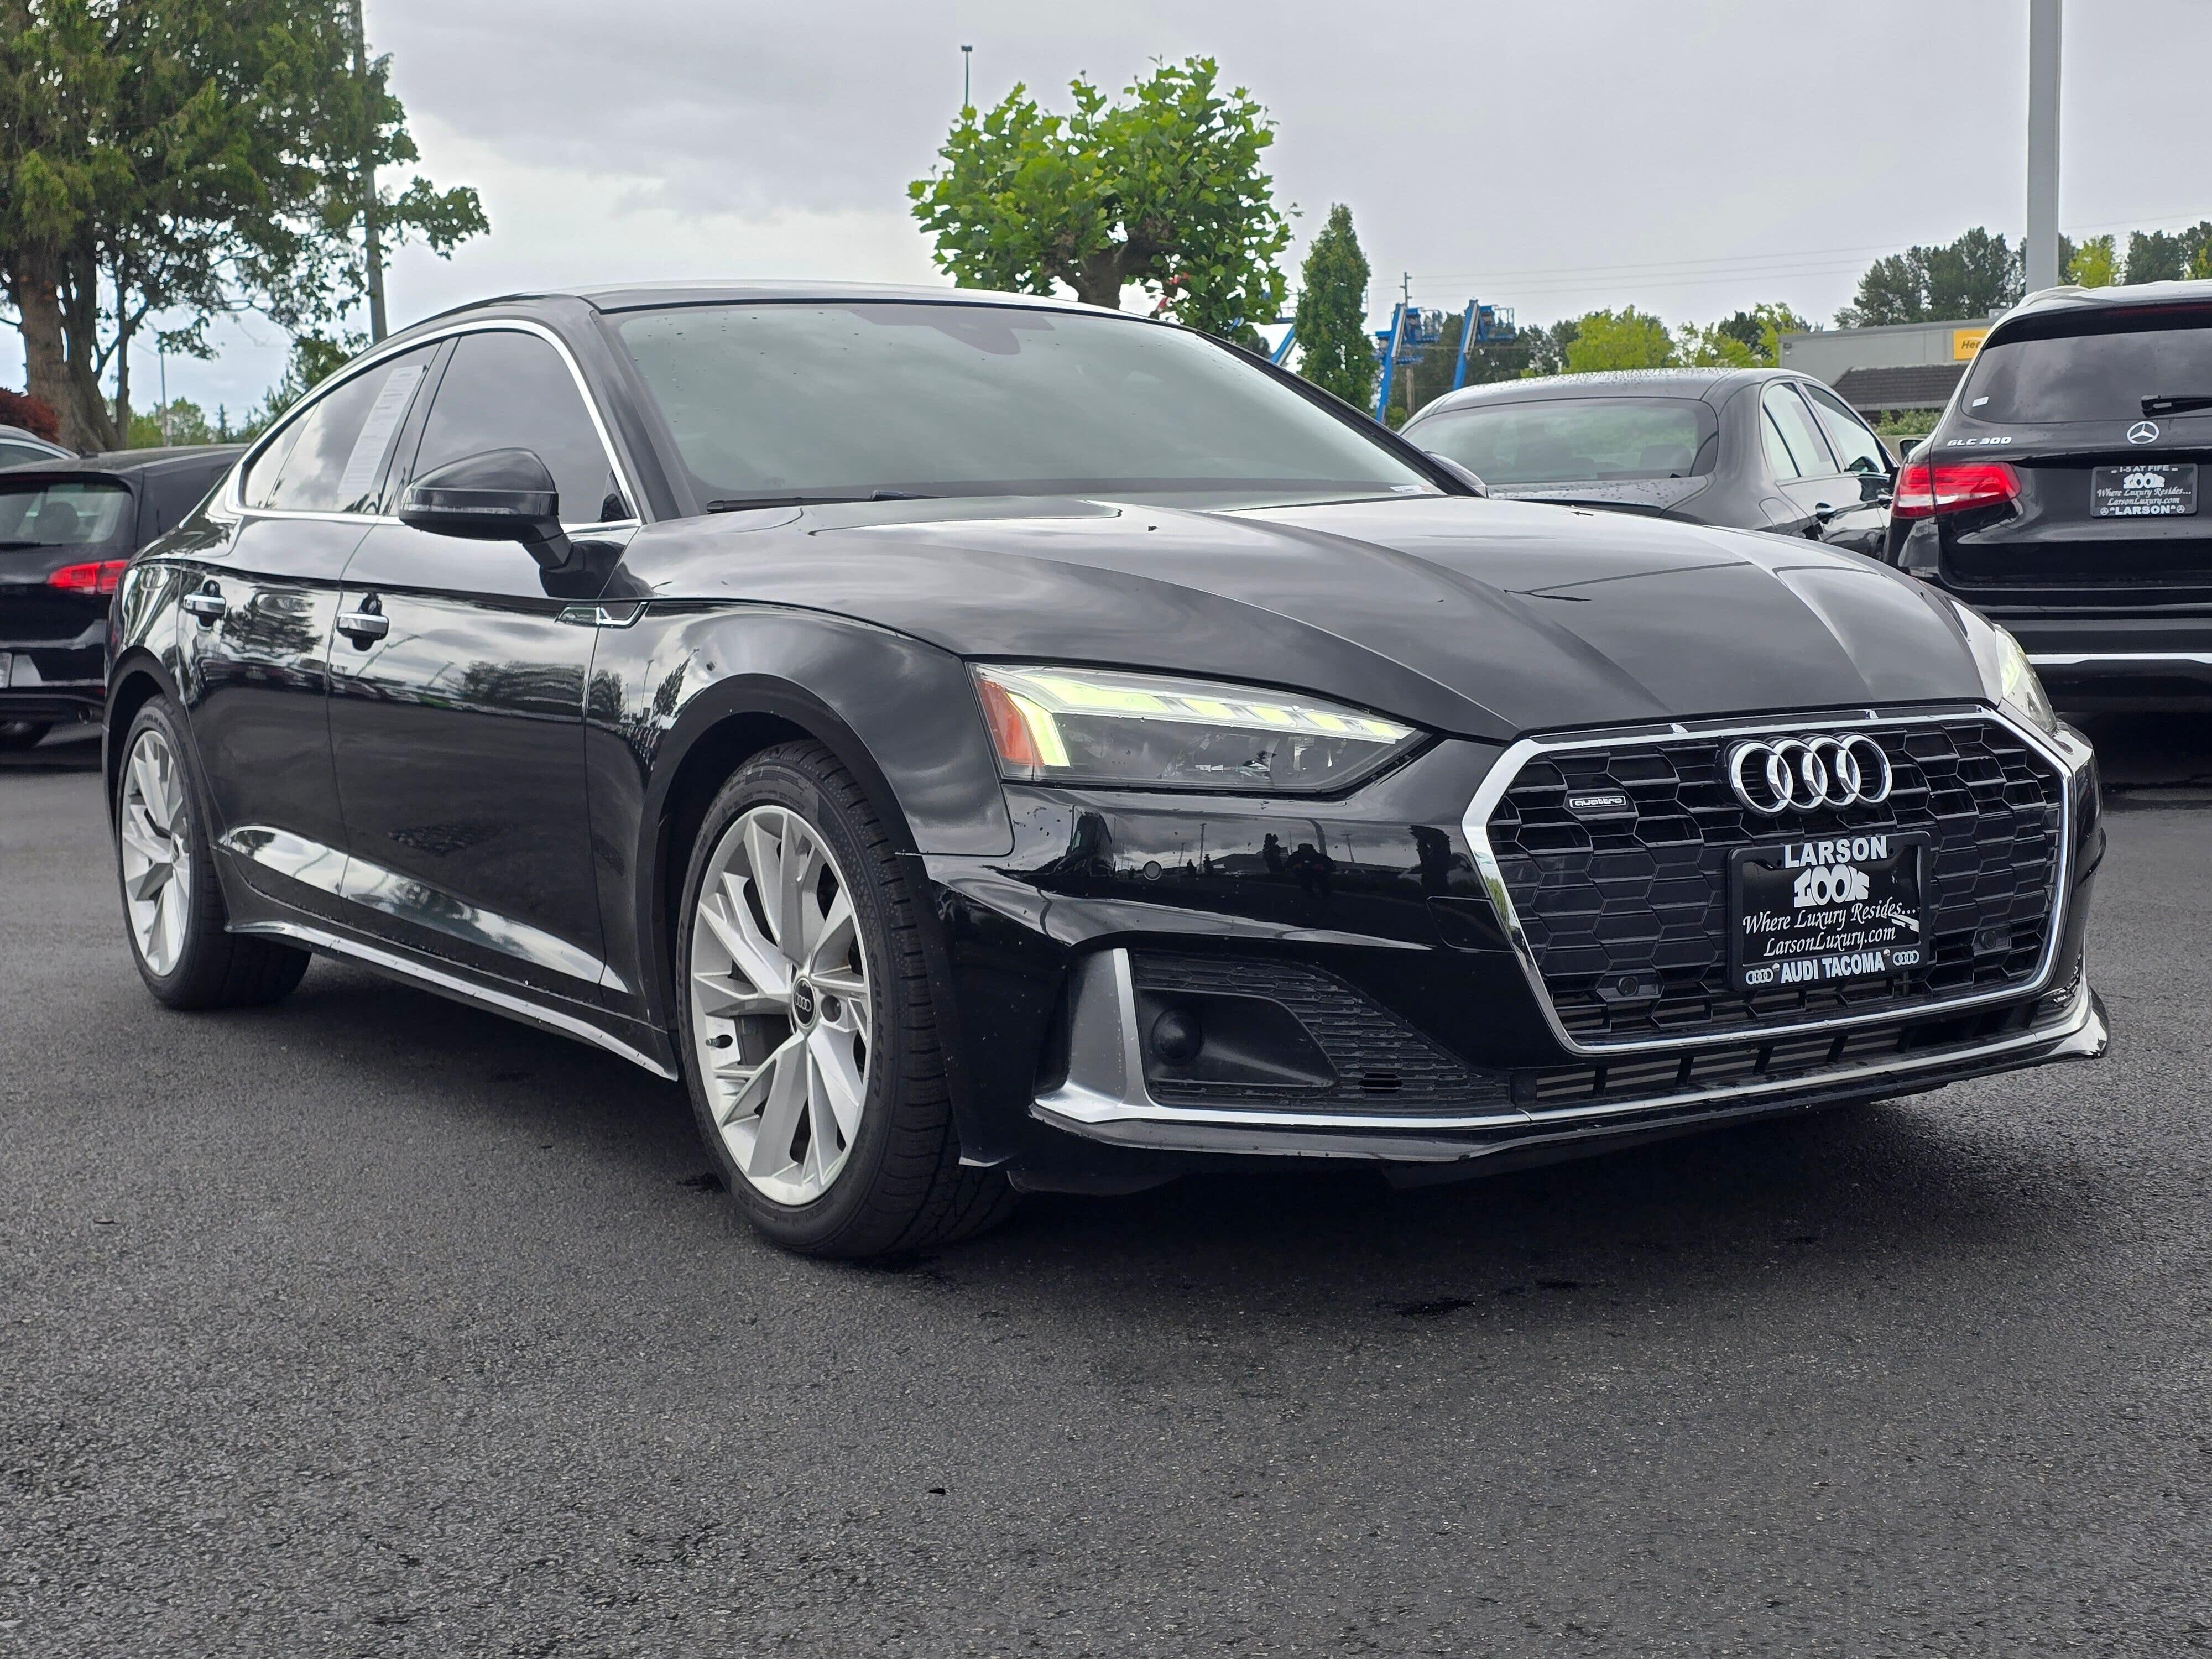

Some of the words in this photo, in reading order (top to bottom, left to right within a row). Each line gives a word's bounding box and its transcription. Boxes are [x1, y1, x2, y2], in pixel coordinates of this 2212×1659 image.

[1961, 340, 1981, 349] Her
[1979, 437, 2012, 445] 300
[2096, 488, 2122, 497] Where
[2123, 489, 2152, 498] Luxury
[2107, 497, 2180, 506] LarsonLuxury.com
[2115, 505, 2171, 515] LARSON
[1574, 797, 1623, 807] quattro
[1784, 836, 1887, 868] LARSON
[1743, 911, 1791, 935] Where
[1794, 907, 1847, 931] Luxury
[1763, 926, 1897, 957] LarsonLuxury.com
[1781, 959, 1819, 984] AUDI
[1822, 951, 1886, 978] TACOMA
